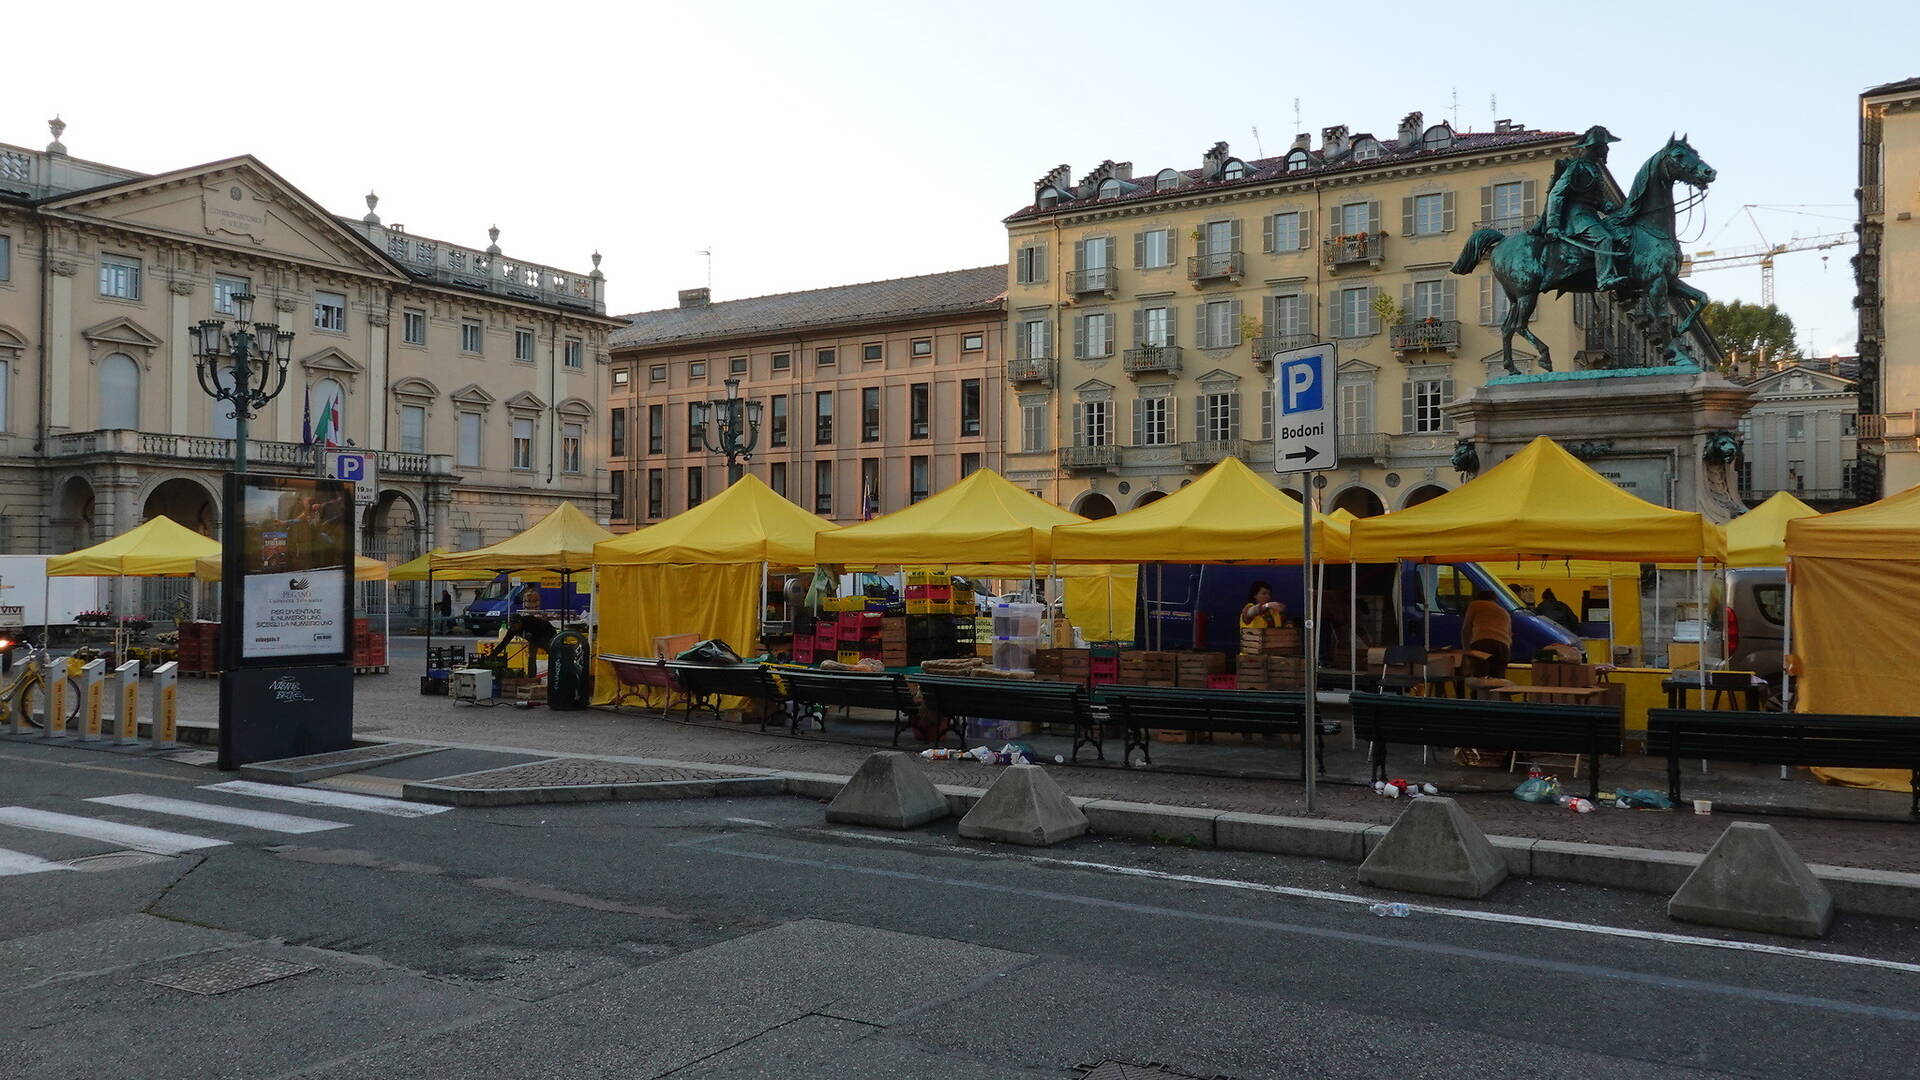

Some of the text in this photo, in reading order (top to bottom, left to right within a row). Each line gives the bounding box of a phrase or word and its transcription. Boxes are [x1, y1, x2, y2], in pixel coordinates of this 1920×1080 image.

[1288, 363, 1314, 409] P
[1281, 422, 1323, 440] Bodoni
[343, 458, 359, 478] P
